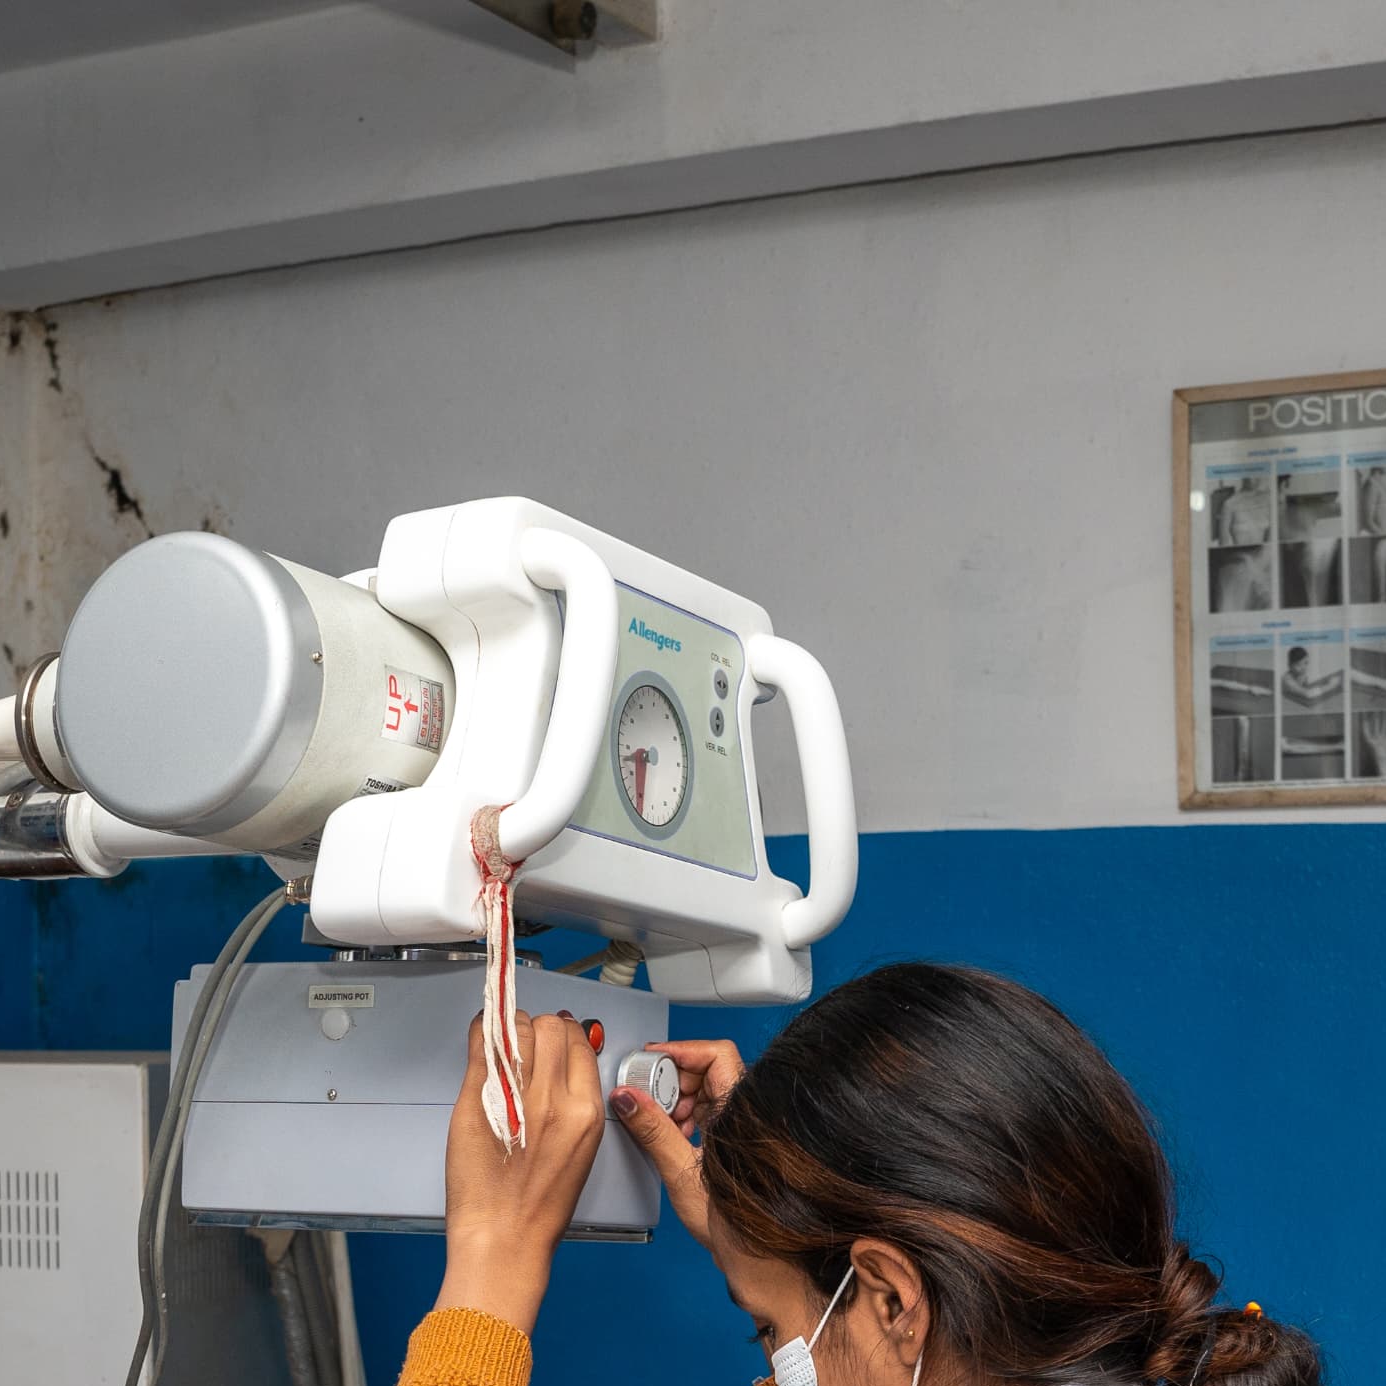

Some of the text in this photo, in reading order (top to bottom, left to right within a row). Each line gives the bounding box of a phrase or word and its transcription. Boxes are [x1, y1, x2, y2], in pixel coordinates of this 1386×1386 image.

[628, 617, 682, 652] Allengers
[386, 674, 402, 731] UP
[365, 777, 398, 793] TOSHIBA
[313, 992, 370, 1000] ADJUSTING POT
